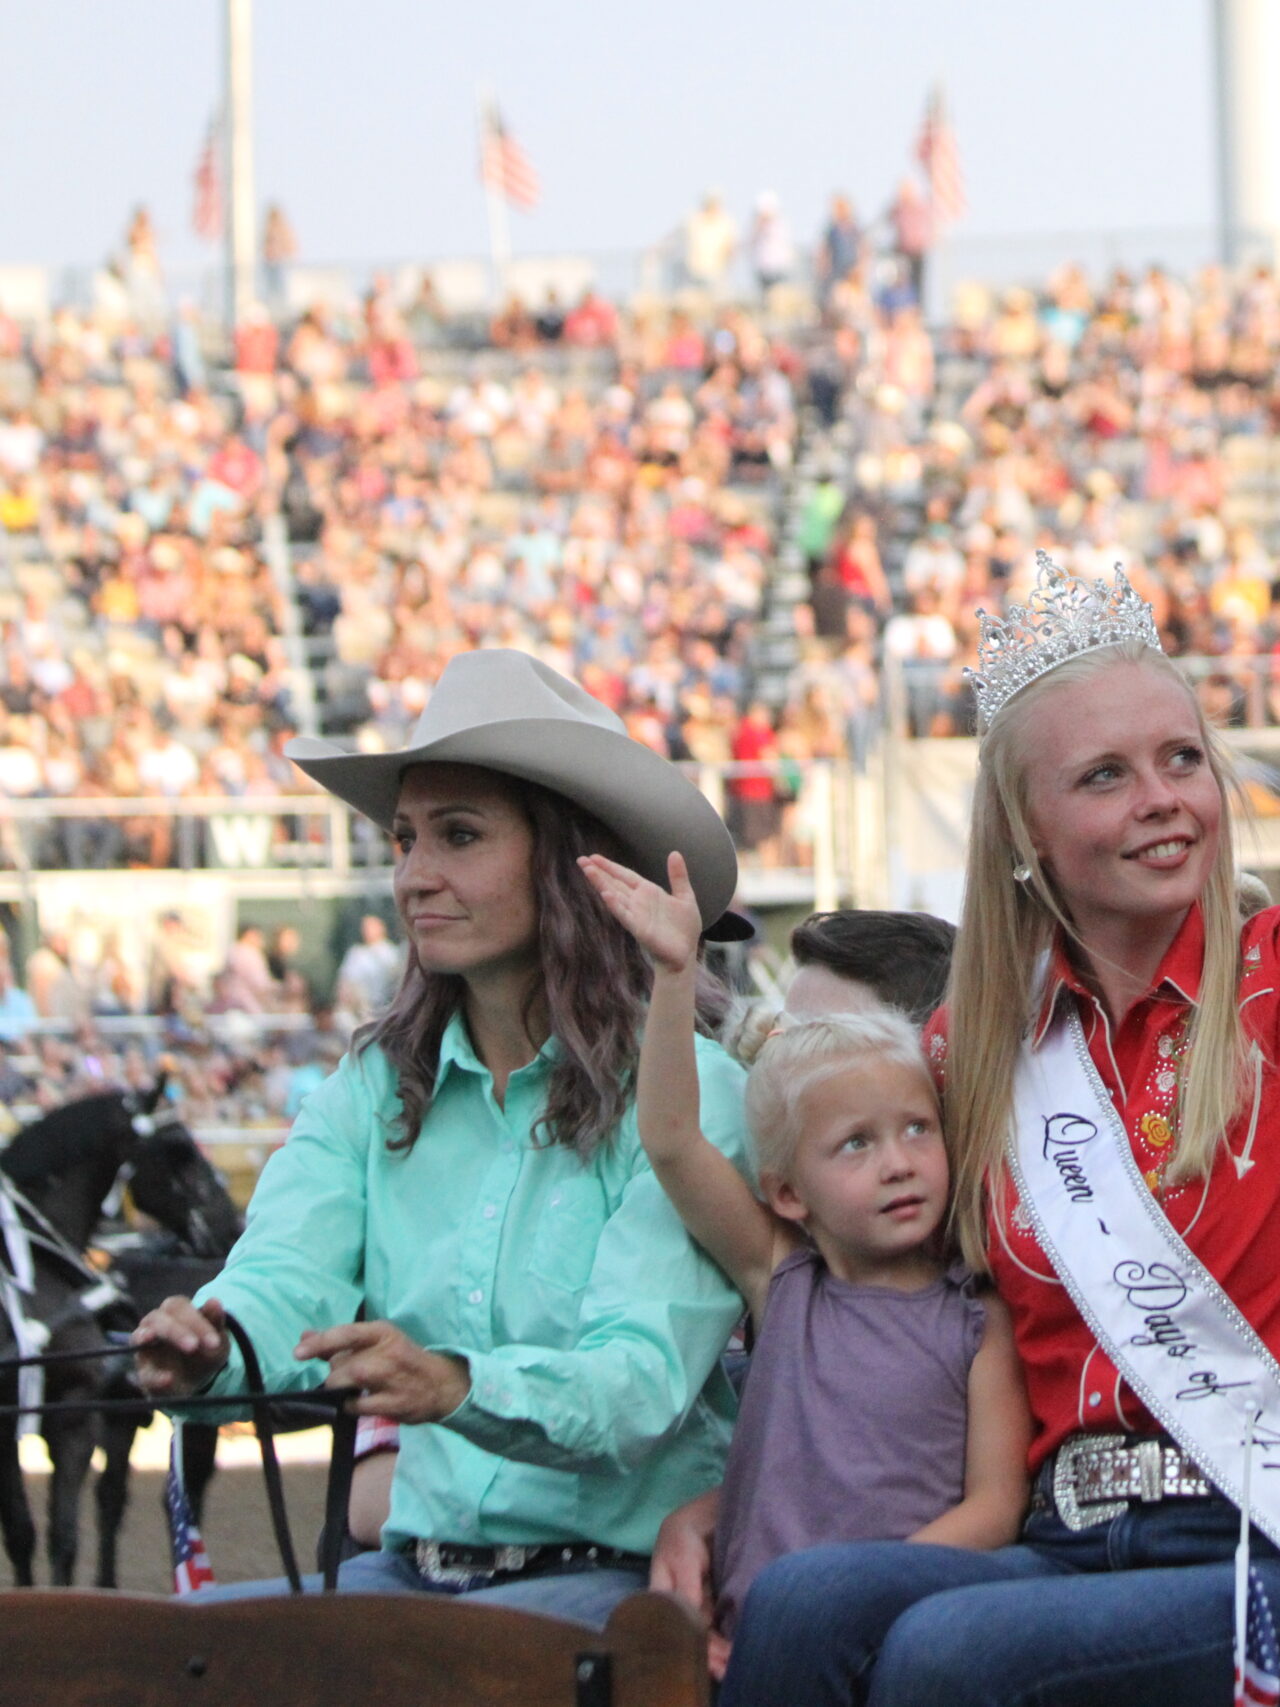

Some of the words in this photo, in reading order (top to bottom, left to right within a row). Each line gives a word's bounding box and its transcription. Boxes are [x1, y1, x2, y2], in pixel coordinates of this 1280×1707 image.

[1041, 1112, 1098, 1203] Queen
[1113, 1260, 1196, 1361] Days
[1176, 1371, 1252, 1400] of
